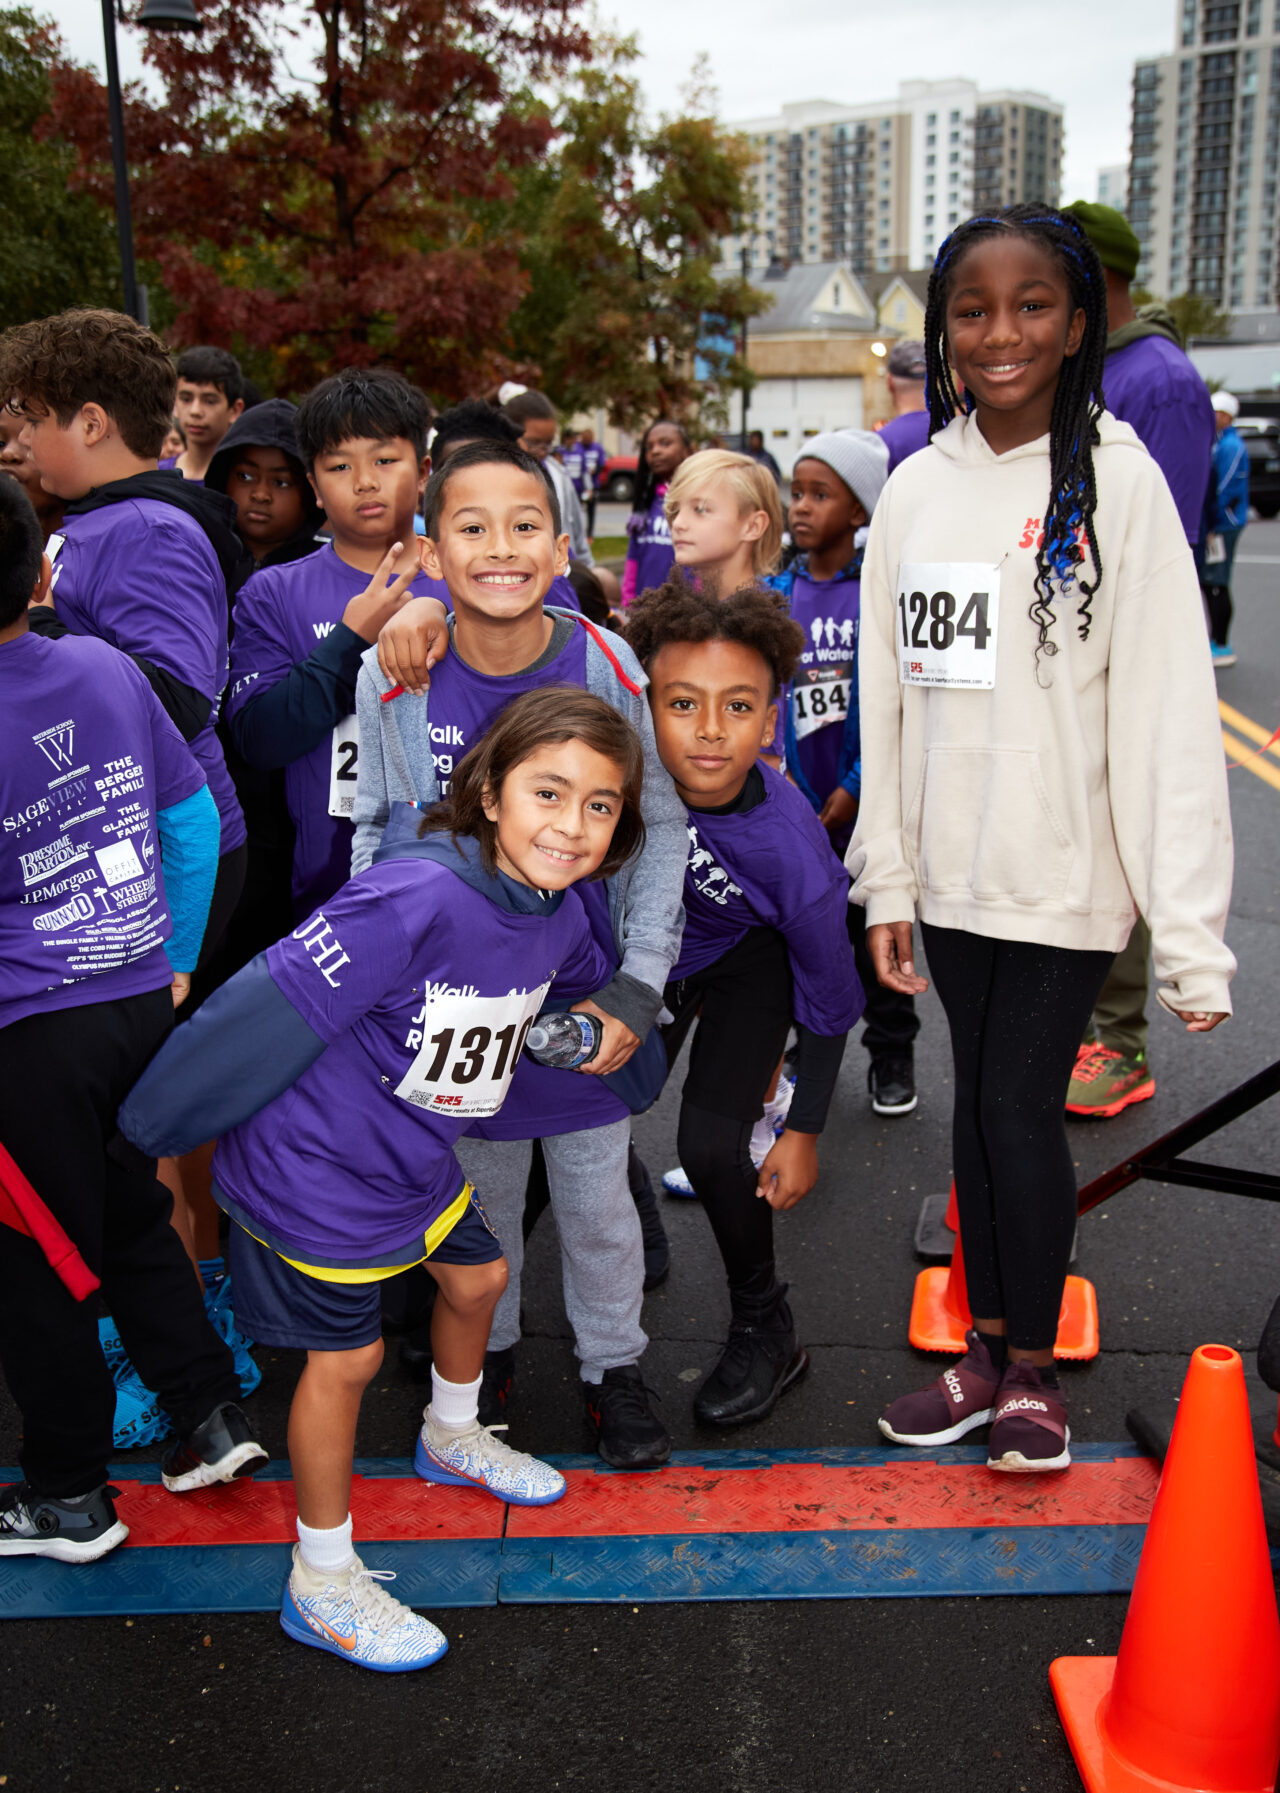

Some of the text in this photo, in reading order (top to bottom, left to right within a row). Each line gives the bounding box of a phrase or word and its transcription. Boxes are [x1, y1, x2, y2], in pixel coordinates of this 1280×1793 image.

[899, 591, 992, 650] 1284
[796, 684, 851, 720] 184
[55, 719, 75, 731] SCHOOL
[103, 755, 134, 773] THE
[3, 778, 88, 833] SAGEVIEW
[117, 802, 141, 816] THE
[116, 891, 148, 910] STREET
[293, 911, 351, 989] JHL
[433, 1094, 464, 1106] SRS
